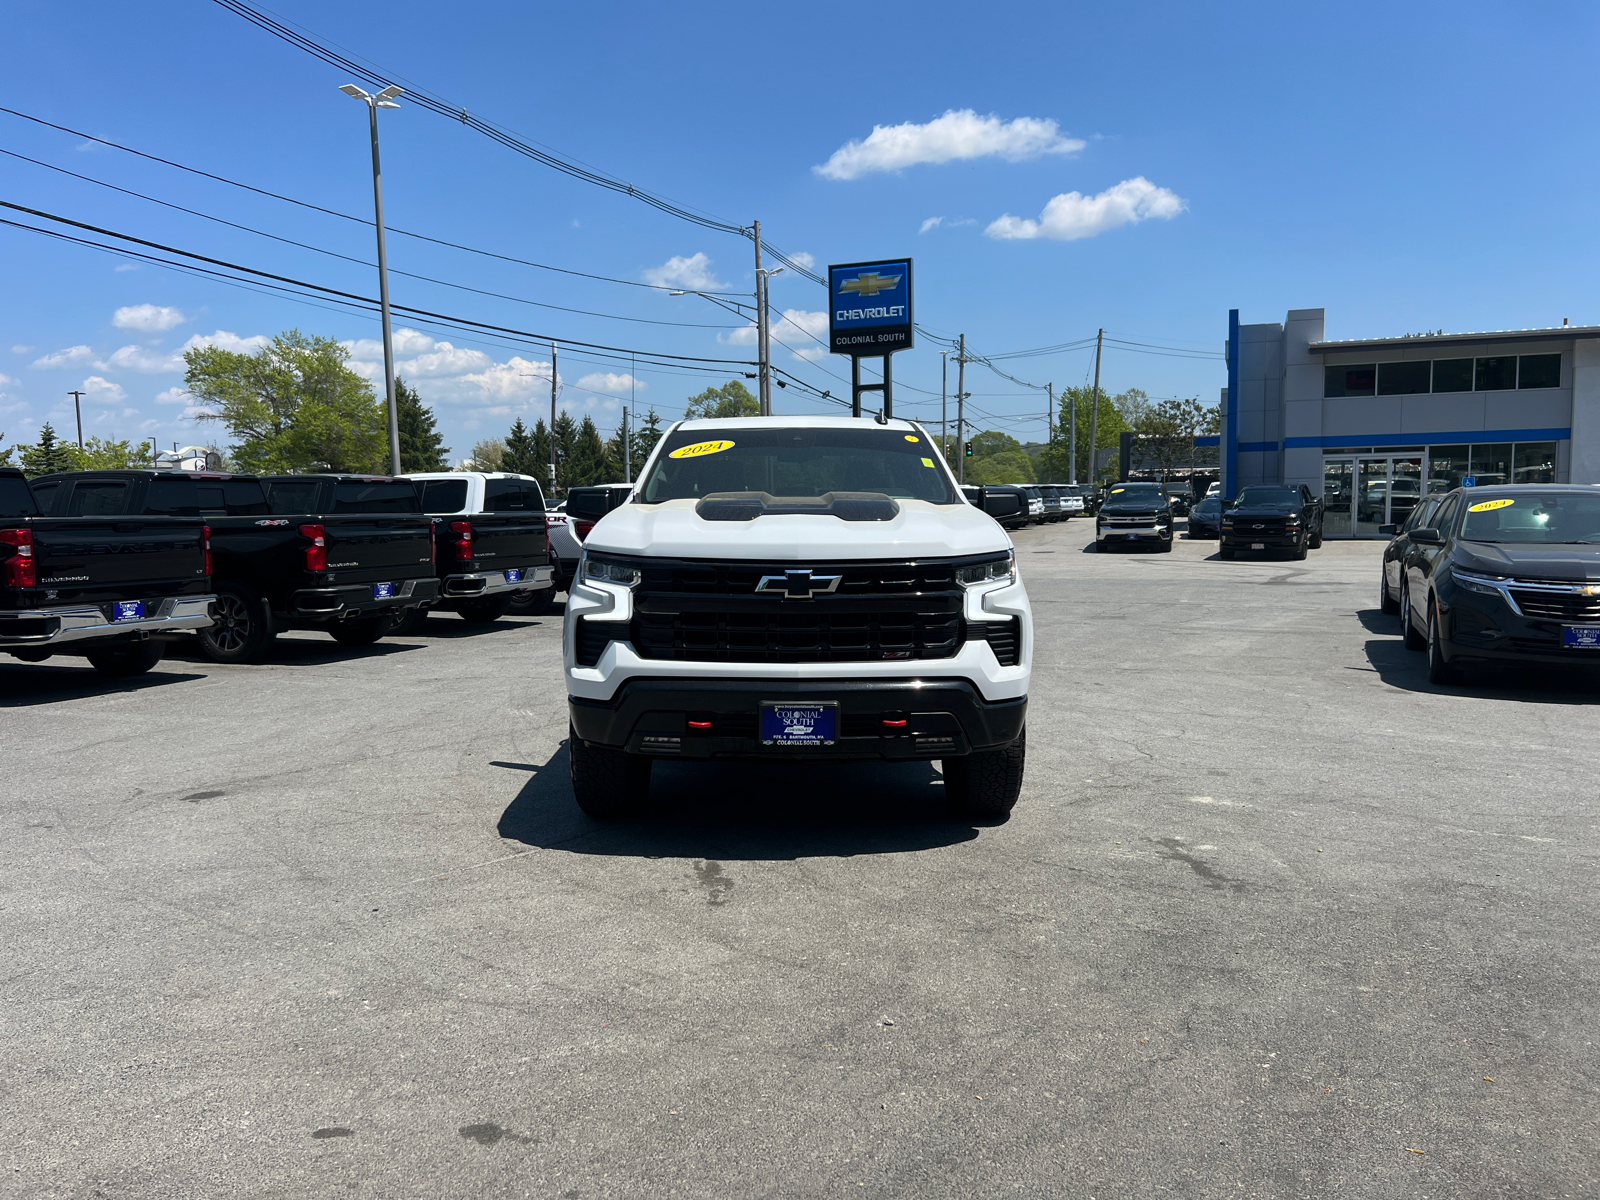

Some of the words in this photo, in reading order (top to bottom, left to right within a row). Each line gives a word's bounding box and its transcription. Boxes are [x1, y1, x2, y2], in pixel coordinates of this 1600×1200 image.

[836, 305, 905, 321] CHEVROLET
[836, 335, 875, 345] COLONIAL
[877, 333, 905, 342] SOUTH
[680, 441, 724, 457] 2024
[1478, 500, 1506, 511] 2024
[776, 710, 821, 719] COLONIAL
[783, 718, 814, 726] SOUTH
